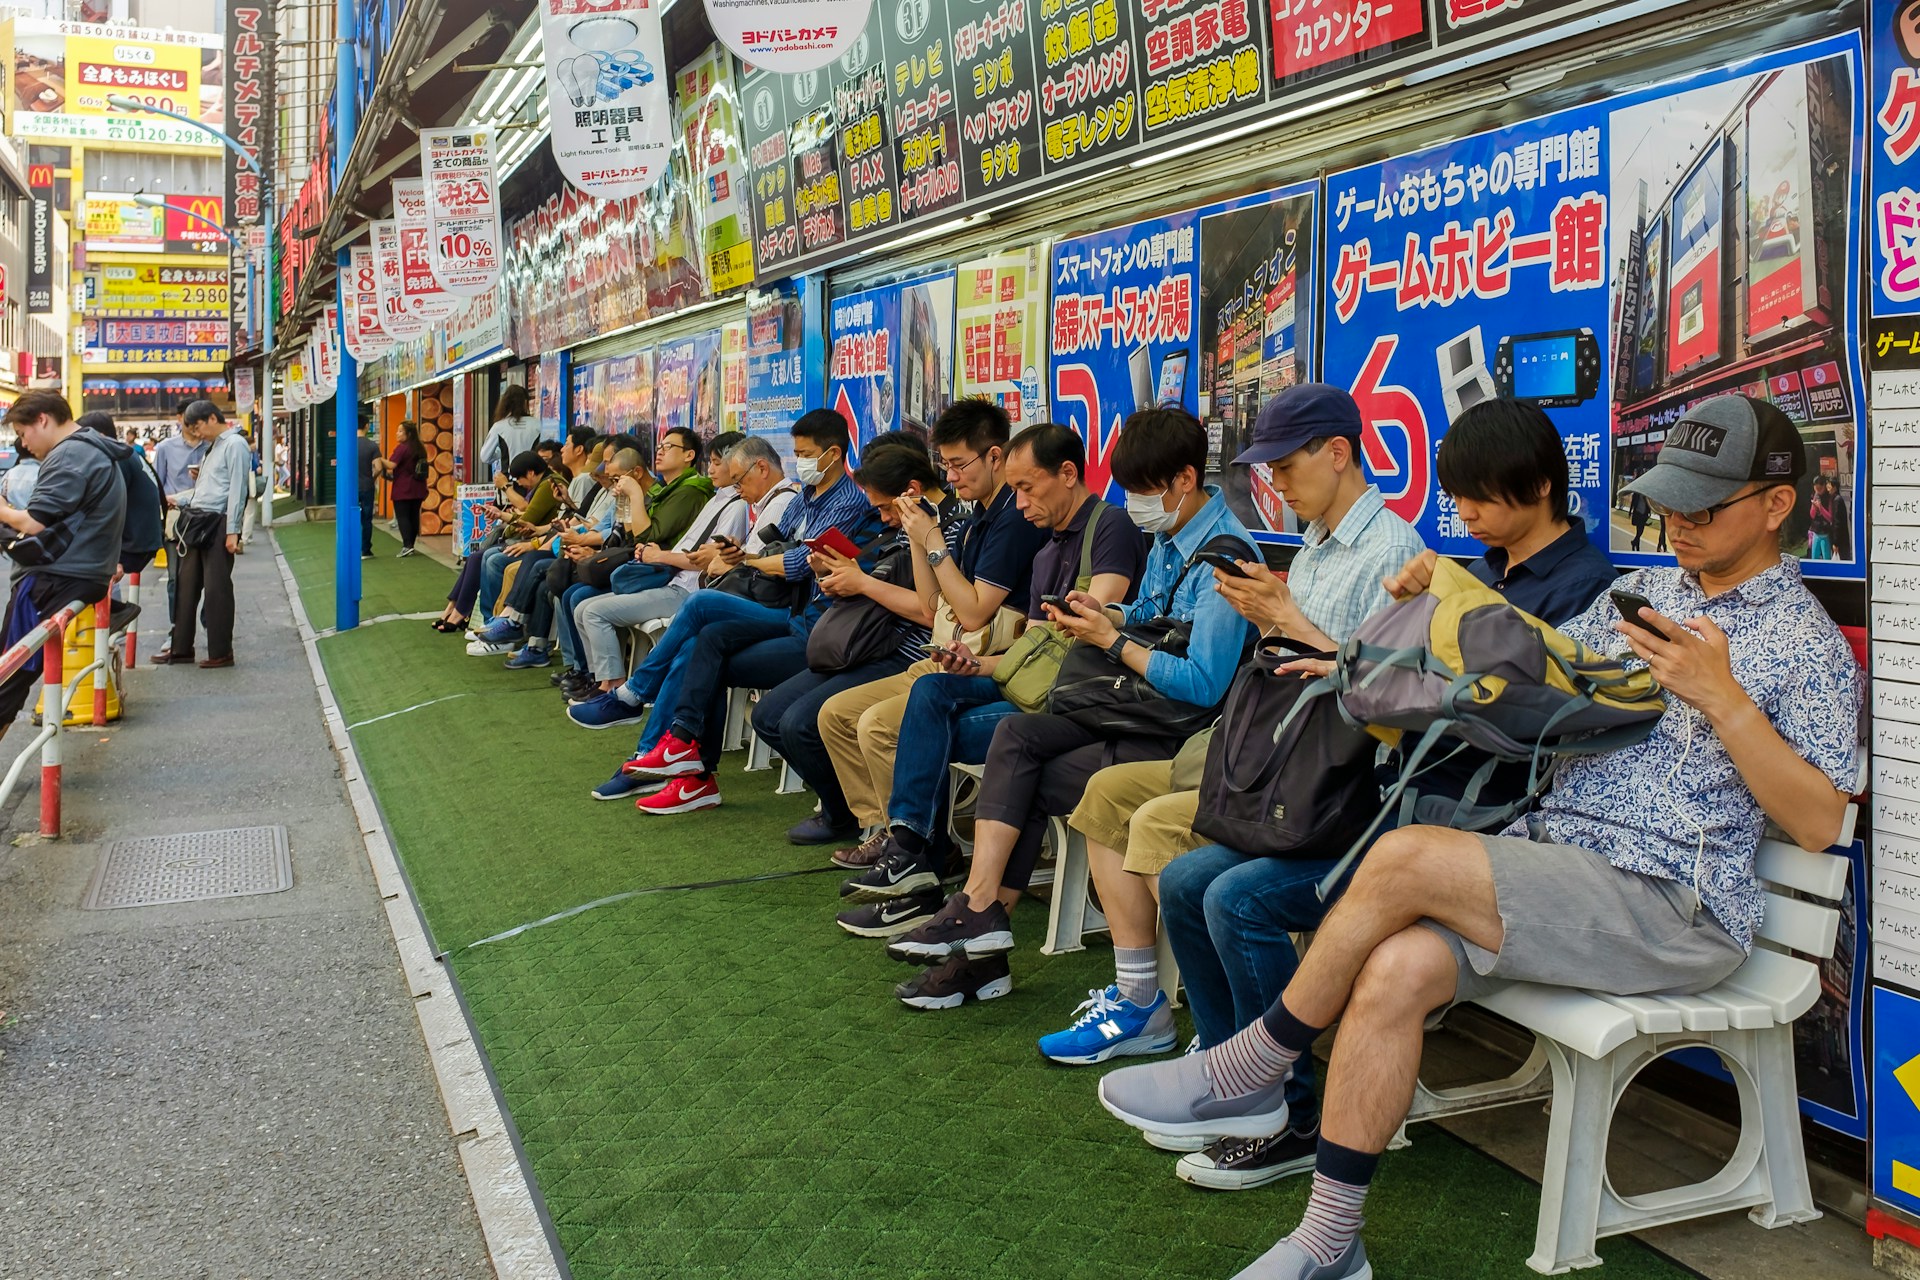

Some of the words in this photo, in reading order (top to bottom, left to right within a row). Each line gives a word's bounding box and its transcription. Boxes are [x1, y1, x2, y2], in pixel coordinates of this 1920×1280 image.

[742, 26, 838, 45] ヨドバシカメラ
[750, 43, 834, 54] www.yodobashi.com
[1044, 0, 1119, 68] 炊飯器
[1145, 0, 1248, 76] 空調家電
[1294, 2, 1394, 60] カウンター
[82, 64, 186, 89] 全身もみほぐし
[894, 38, 944, 97] テレビ
[973, 46, 1015, 99] コンポ
[1042, 40, 1130, 116] オーブンレンジ
[1145, 44, 1260, 131] 空気清浄機
[574, 106, 644, 128] 照明器具
[591, 126, 631, 144] 工具
[894, 83, 951, 136] レコーダー
[964, 90, 1031, 144] ヘッドフォン
[1045, 94, 1134, 163] 電子レンジ
[581, 166, 648, 181] ヨドバシカメラ
[757, 164, 786, 201] インク
[803, 150, 822, 180] Mac
[850, 151, 886, 194] FAX
[981, 137, 1021, 186] ラジオ
[1335, 126, 1600, 233] ゲーム・おもちゃの専門館
[34, 199, 48, 275] McDonald's
[201, 241, 218, 253] 24
[440, 233, 492, 260] 10%
[760, 225, 796, 263] メディア
[803, 209, 836, 248] デジカメ
[1883, 196, 1920, 250] ド
[1057, 226, 1194, 286] スマートフォンの専門館
[1332, 191, 1607, 324] ゲームホビー館
[1622, 231, 1642, 334] ヨドバシカメラ
[1053, 273, 1192, 355] 携帯・スマートフォン売場
[771, 355, 802, 387] 友都八喜
[1562, 433, 1601, 461] 左折
[469, 503, 484, 540] セール
